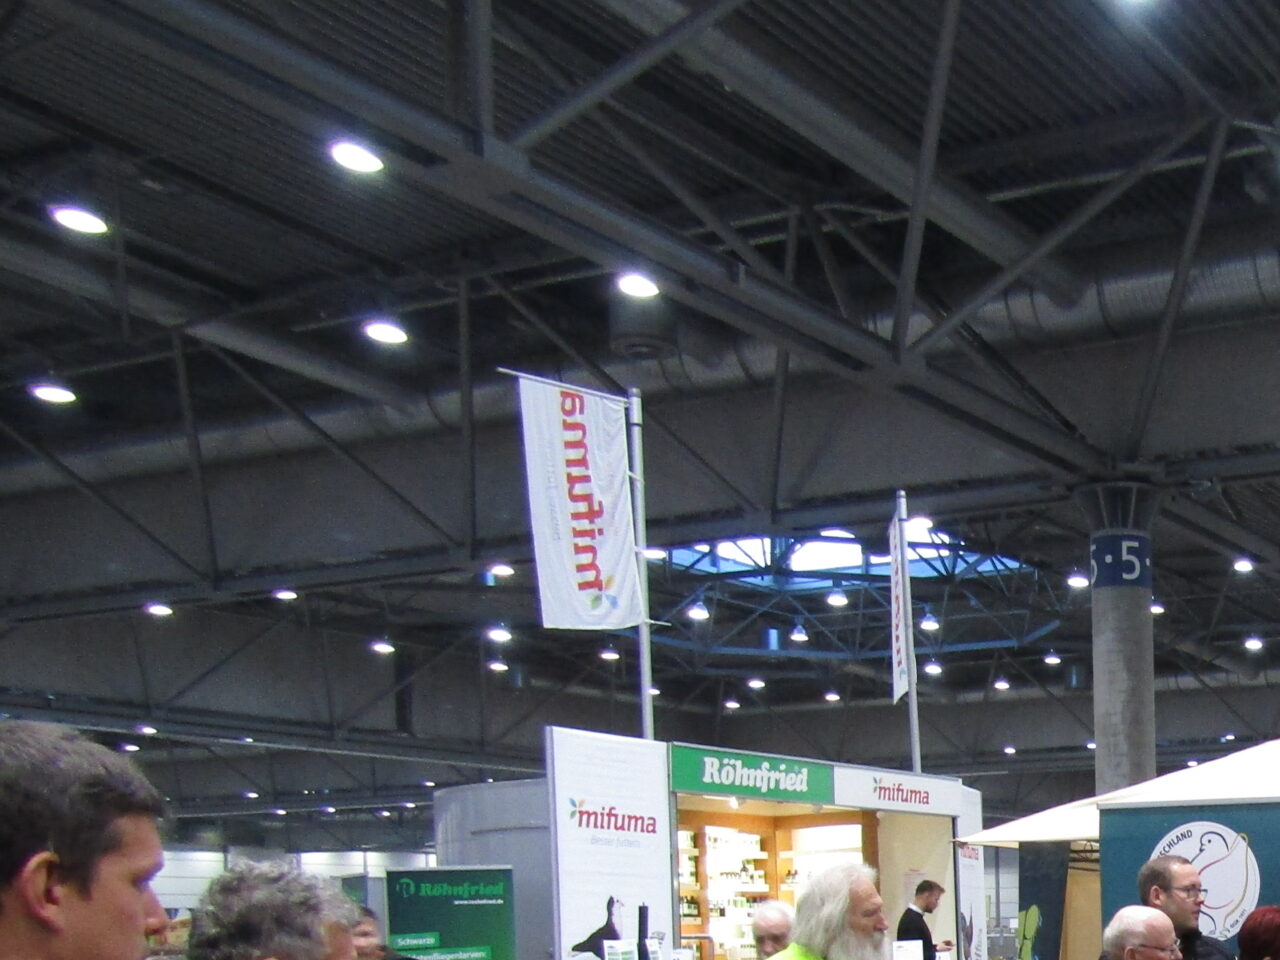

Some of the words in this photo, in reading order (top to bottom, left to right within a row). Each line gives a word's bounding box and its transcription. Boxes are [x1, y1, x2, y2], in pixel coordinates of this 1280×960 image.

[702, 757, 808, 793] Röhnfried
[877, 783, 930, 805] mifuma
[577, 806, 657, 834] mifuma
[1157, 829, 1193, 858] SCHLAND
[419, 882, 504, 899] Röhnfried
